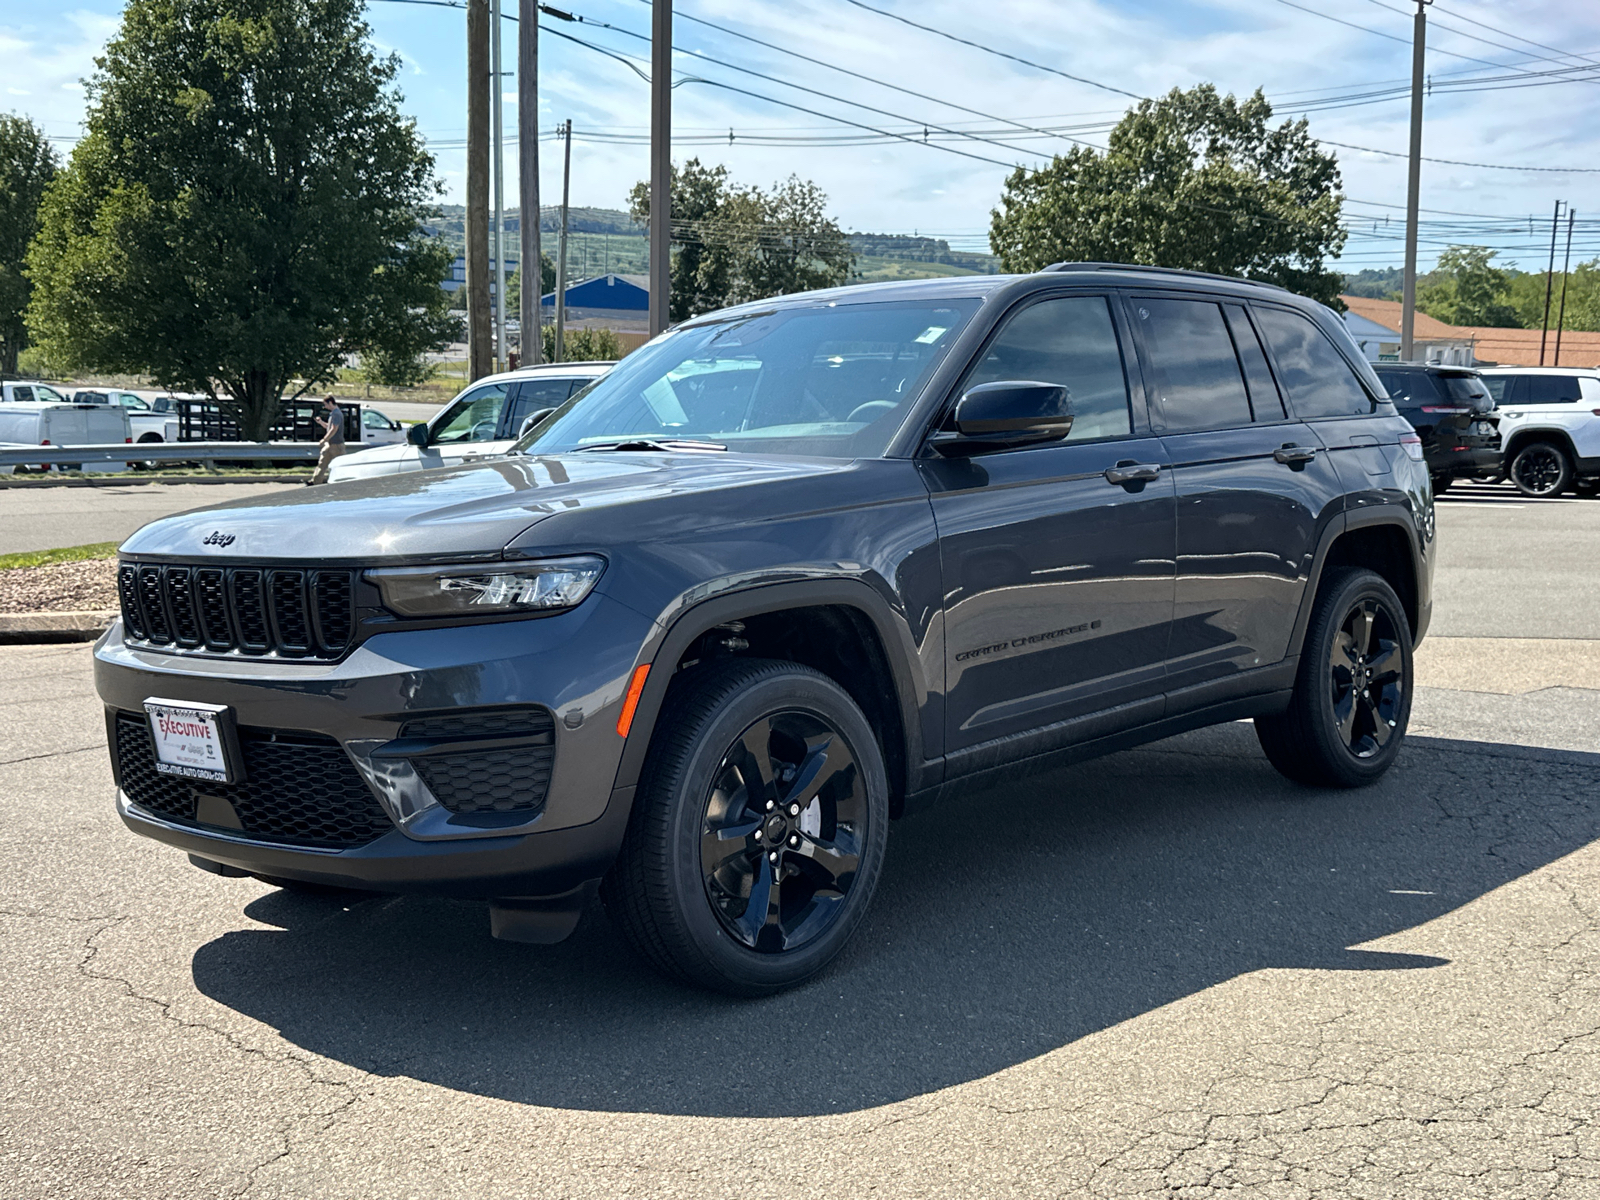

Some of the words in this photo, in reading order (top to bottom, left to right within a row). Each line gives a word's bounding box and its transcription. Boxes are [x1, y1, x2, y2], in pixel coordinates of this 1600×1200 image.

[203, 530, 236, 548] Jeep
[955, 642, 1009, 662] GRAND
[1011, 622, 1089, 648] CHEROKEE
[159, 714, 212, 741] EXECUTIVE
